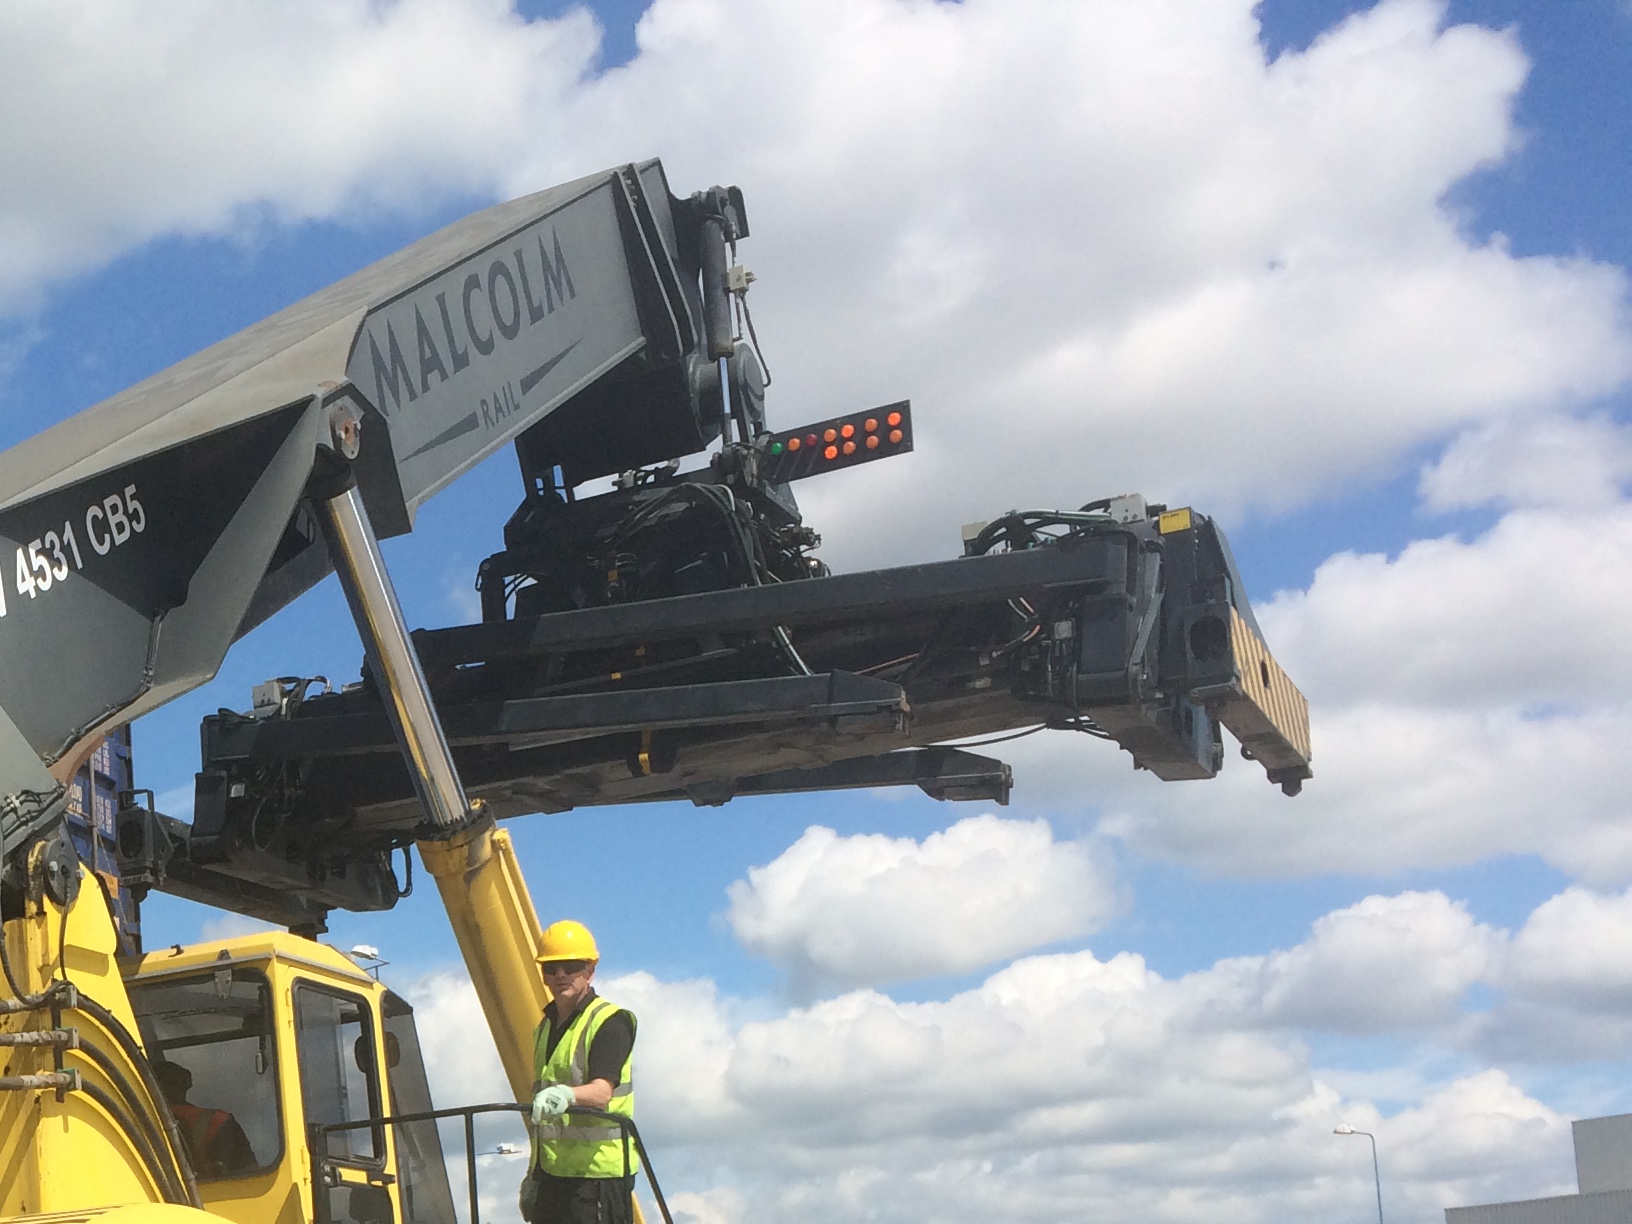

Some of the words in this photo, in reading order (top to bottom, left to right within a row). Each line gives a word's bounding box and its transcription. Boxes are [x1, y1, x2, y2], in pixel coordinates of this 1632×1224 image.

[368, 225, 577, 417] MALCOLM
[479, 381, 520, 430] RAIL
[16, 521, 83, 599] 4531
[85, 483, 146, 556] CB5
